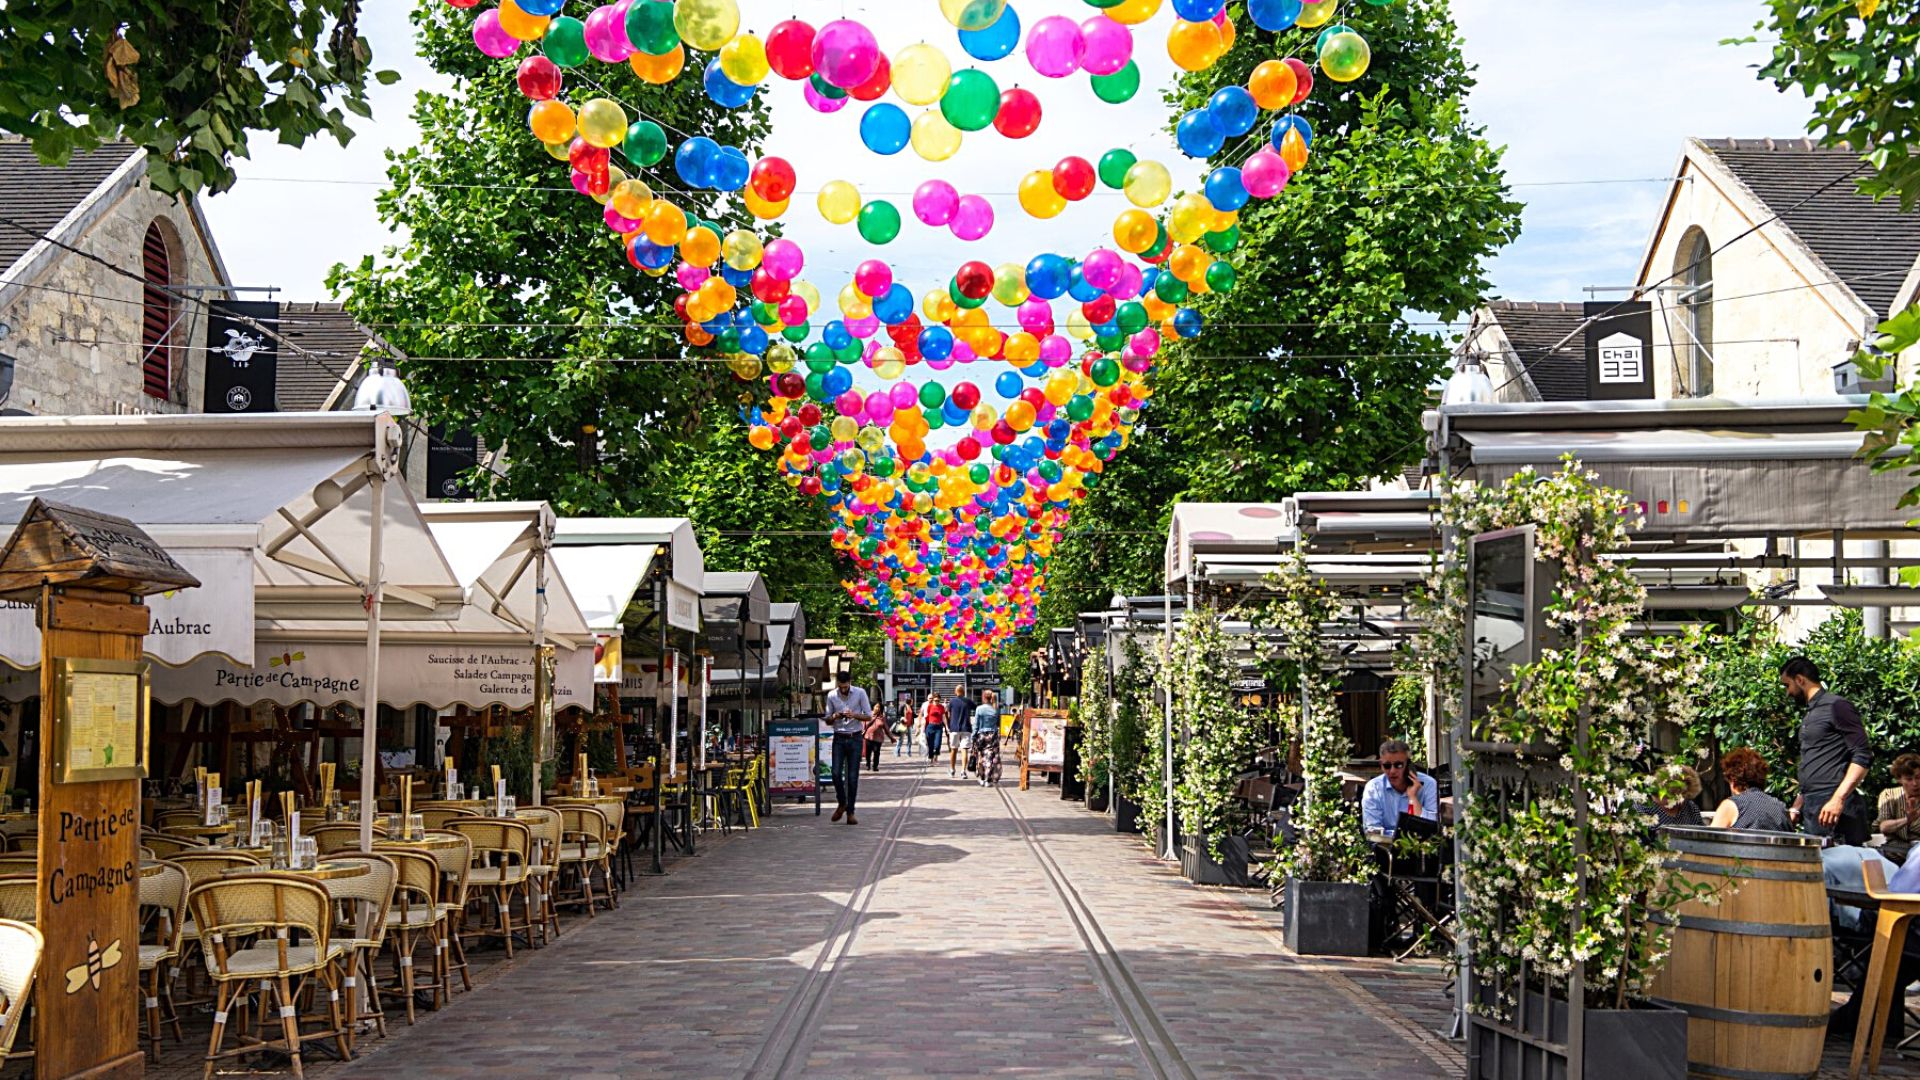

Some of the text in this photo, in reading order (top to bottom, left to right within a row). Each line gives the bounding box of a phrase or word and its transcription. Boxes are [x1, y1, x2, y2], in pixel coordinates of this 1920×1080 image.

[1604, 361, 1639, 377] 33
[428, 654, 465, 664] Saucisse
[467, 654, 479, 664] de
[481, 655, 519, 666] l'Aubrac
[215, 669, 360, 694] Partie de Campagne
[454, 669, 488, 680] Salades
[479, 684, 519, 695] Galettes
[521, 684, 532, 695] de
[58, 808, 134, 843] Partie de
[50, 860, 134, 905] Campagne
